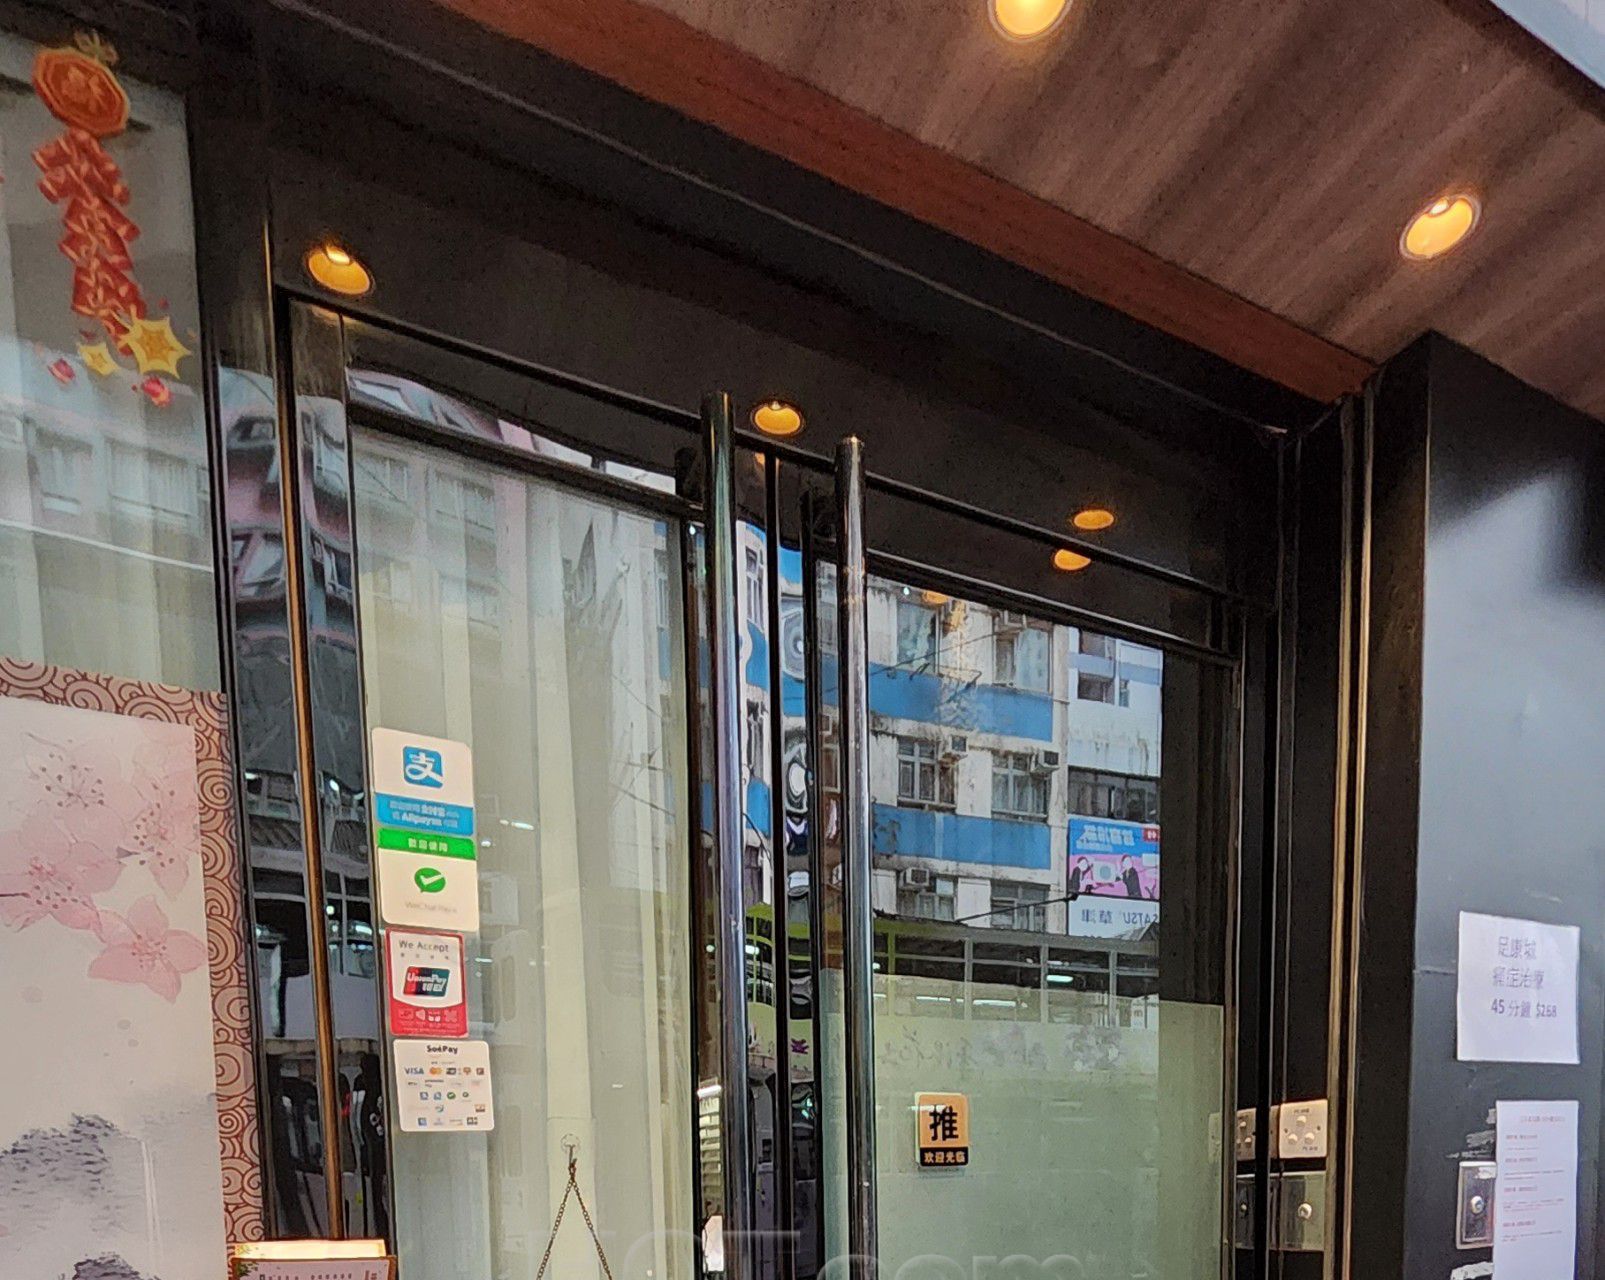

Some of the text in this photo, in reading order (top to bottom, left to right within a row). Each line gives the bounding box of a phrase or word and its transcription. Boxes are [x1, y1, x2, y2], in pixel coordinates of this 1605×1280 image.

[399, 940, 449, 953] We Accept
[1491, 999, 1505, 1014] 45
[404, 1067, 424, 1075] VISA
[929, 1105, 959, 1141] 推
